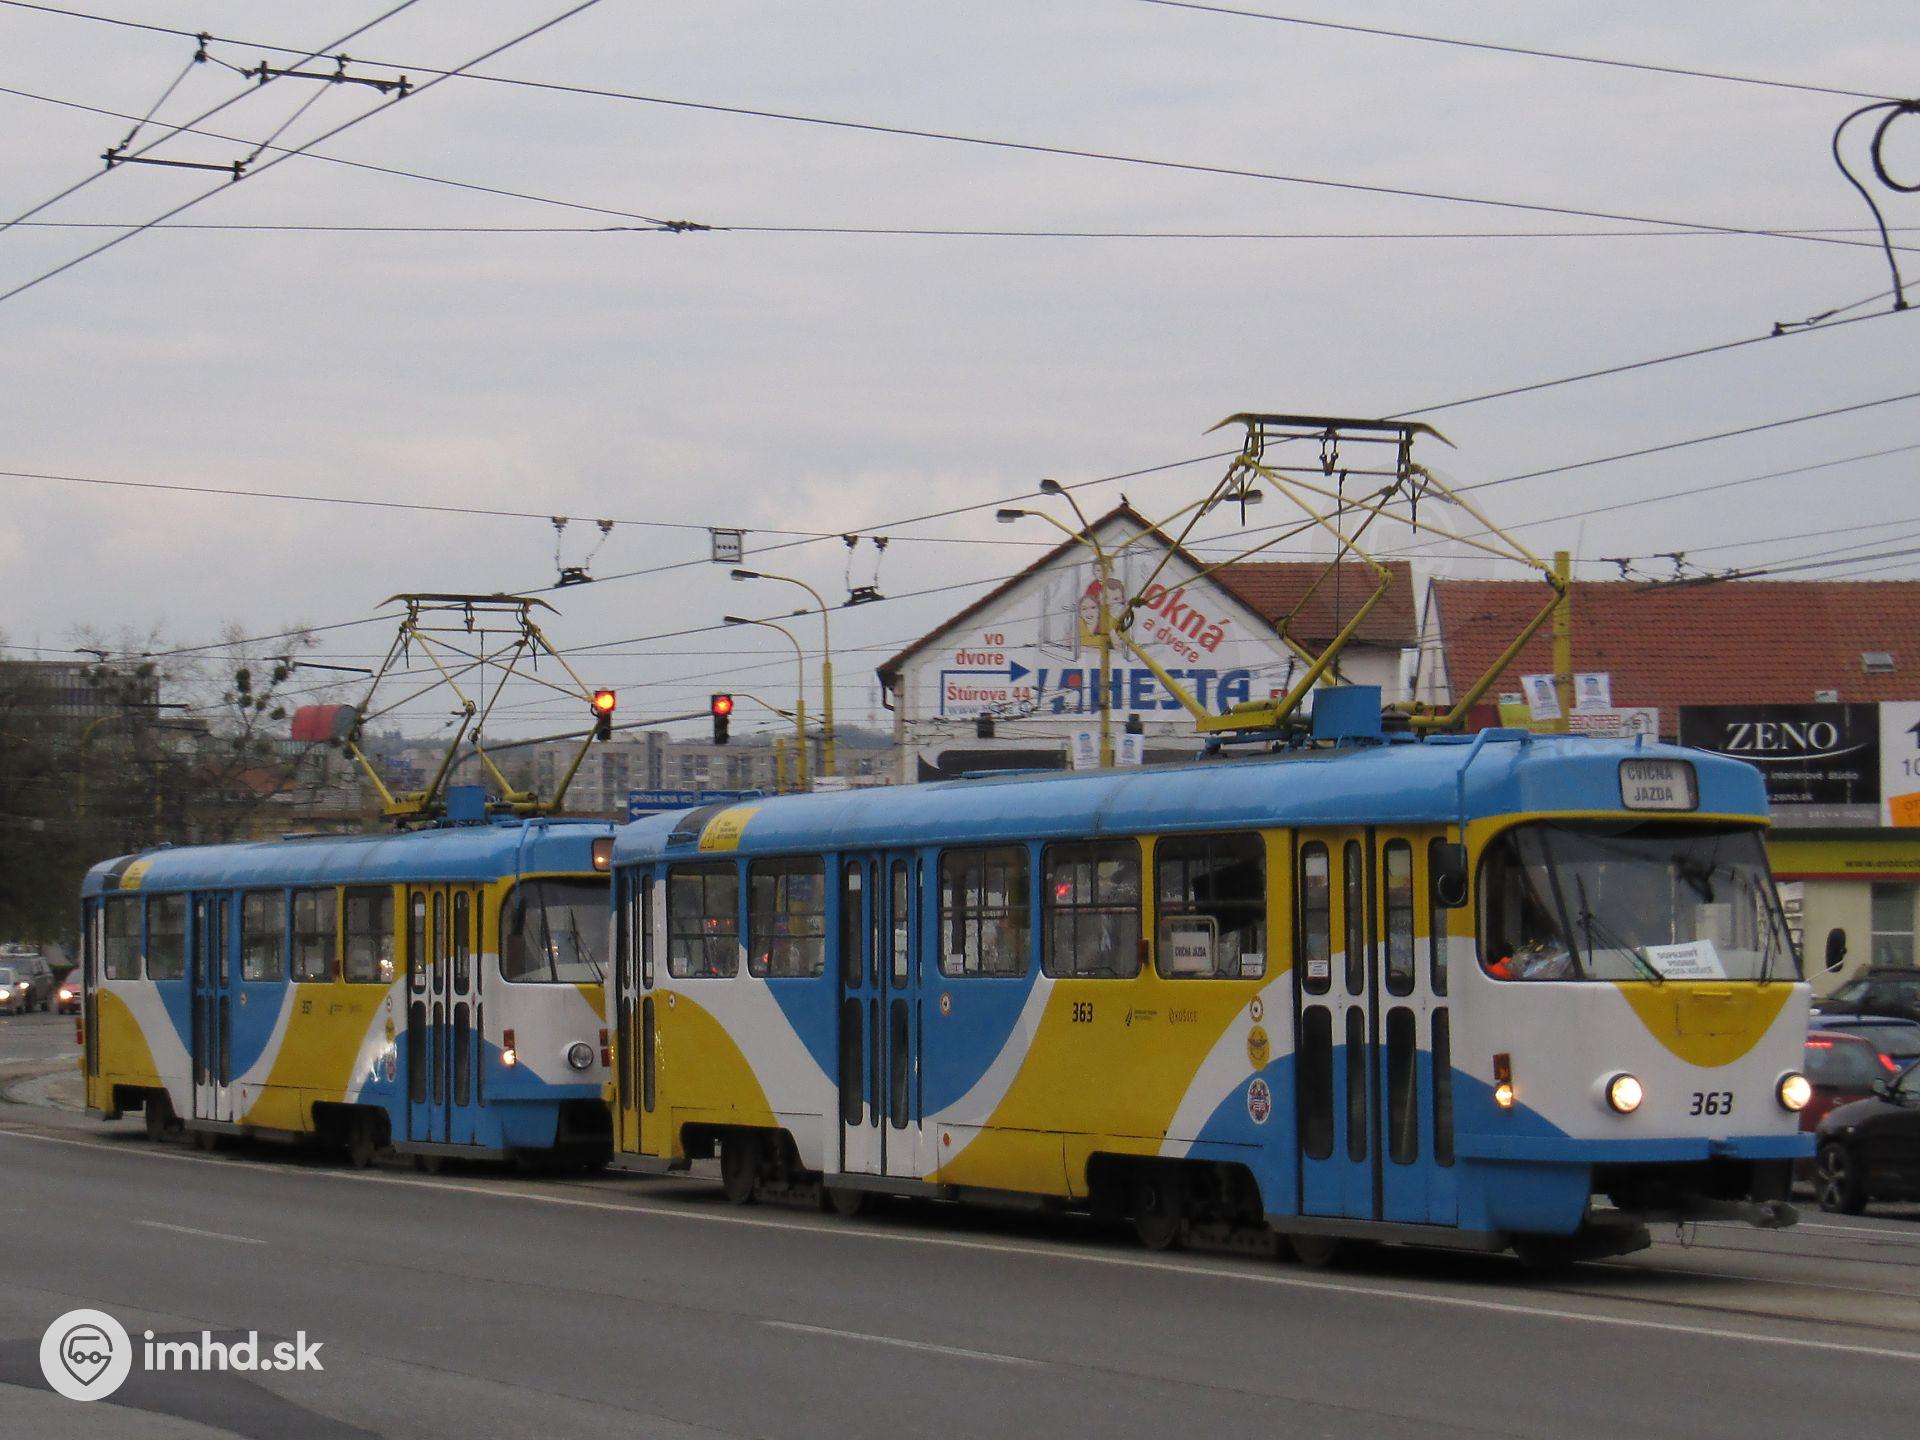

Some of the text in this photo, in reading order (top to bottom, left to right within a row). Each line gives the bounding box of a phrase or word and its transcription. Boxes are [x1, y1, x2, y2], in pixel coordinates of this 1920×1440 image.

[1144, 583, 1232, 653] okná
[984, 633, 1005, 645] vo
[1143, 618, 1200, 663] a dvere
[956, 649, 1005, 665] dvore
[947, 682, 1007, 701] Štúrova
[1725, 722, 1838, 750] ZENO
[1634, 786, 1673, 801] JAZDA
[1072, 1002, 1094, 1023] 363
[1689, 1092, 1734, 1116] 363
